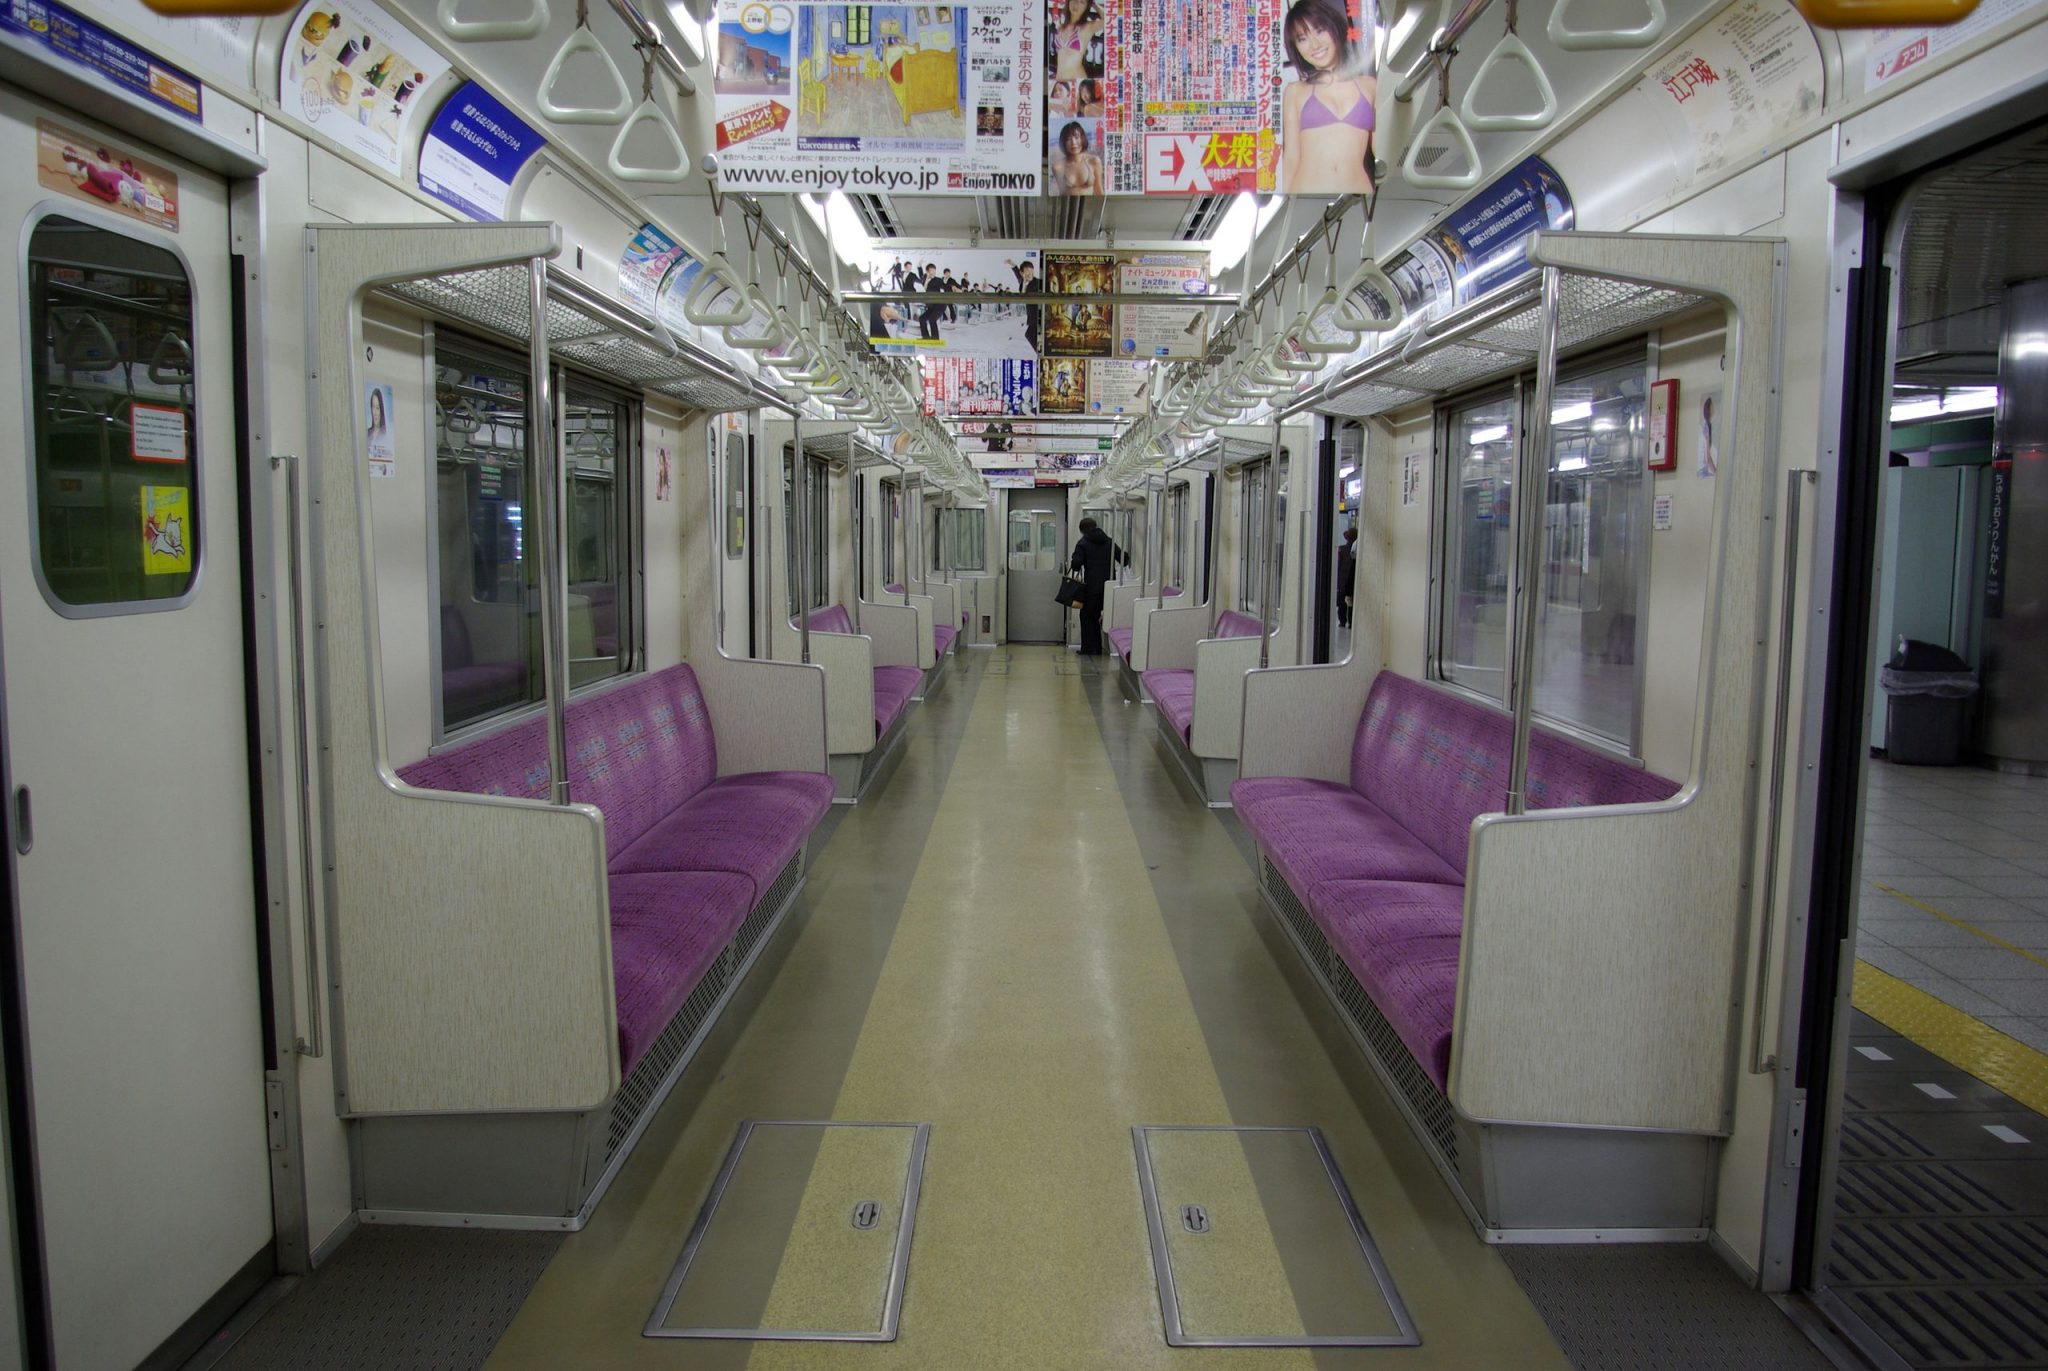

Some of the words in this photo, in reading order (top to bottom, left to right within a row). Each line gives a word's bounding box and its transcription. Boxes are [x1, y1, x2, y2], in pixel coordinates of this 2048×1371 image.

[972, 27, 1013, 37] スウィーツ
[983, 16, 1001, 26] 春の
[1901, 44, 1925, 67] アコム
[1662, 57, 1720, 104] 江戸城
[727, 114, 777, 144] Ranking
[1147, 135, 1213, 191] EX
[1201, 132, 1256, 168] 大衆
[723, 165, 939, 190] www.enjoytokyo.jp
[1989, 473, 2003, 575] ちゅうおうりんかん
